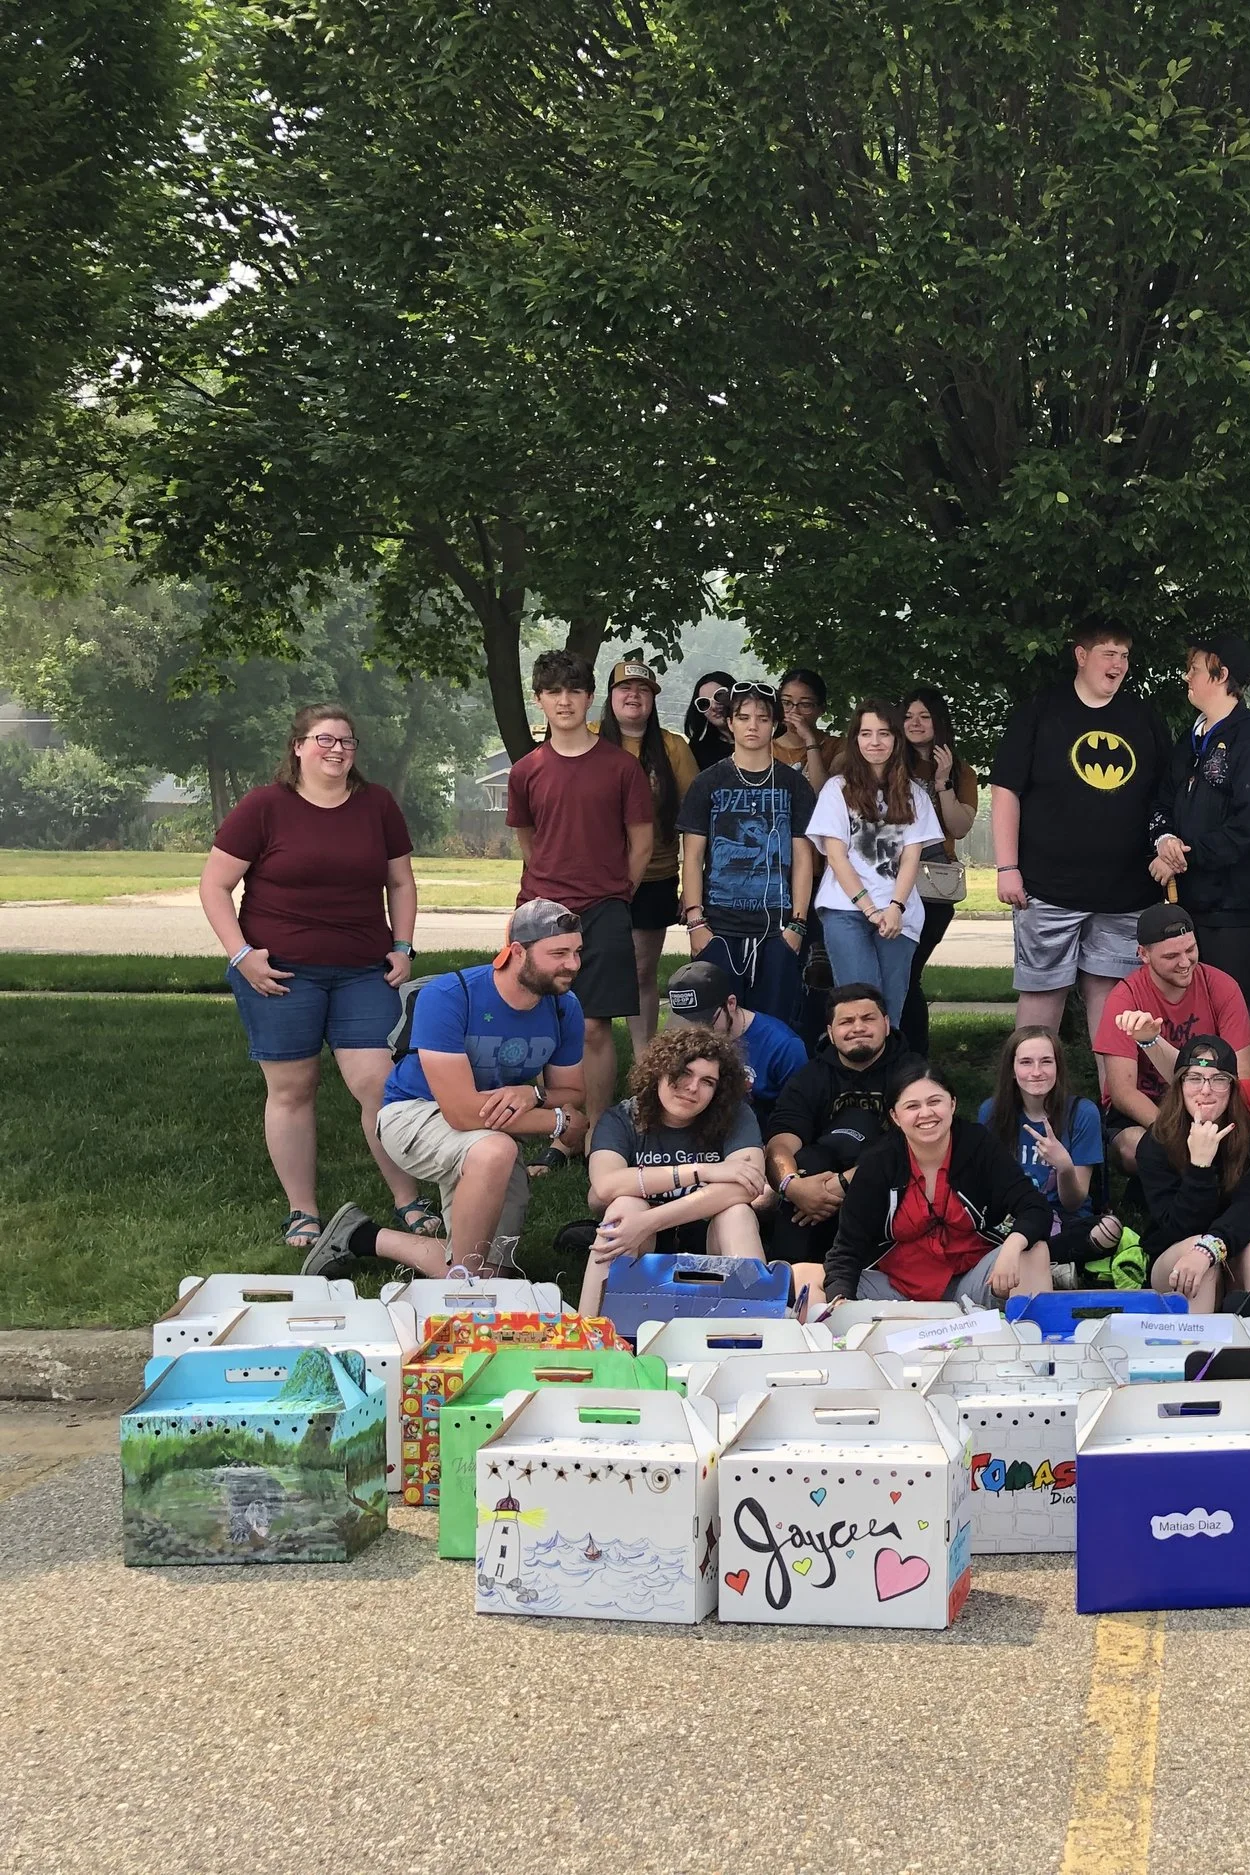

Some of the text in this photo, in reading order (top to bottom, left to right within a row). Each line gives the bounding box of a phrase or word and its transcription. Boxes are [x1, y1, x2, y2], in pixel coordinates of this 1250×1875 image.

[918, 1319, 978, 1341] Simon Martin
[1140, 1320, 1205, 1333] Nevaeh Watts
[971, 1453, 1076, 1495] TOMAS
[1050, 1491, 1077, 1505] Dia
[1159, 1520, 1222, 1532] Matias Diaz
